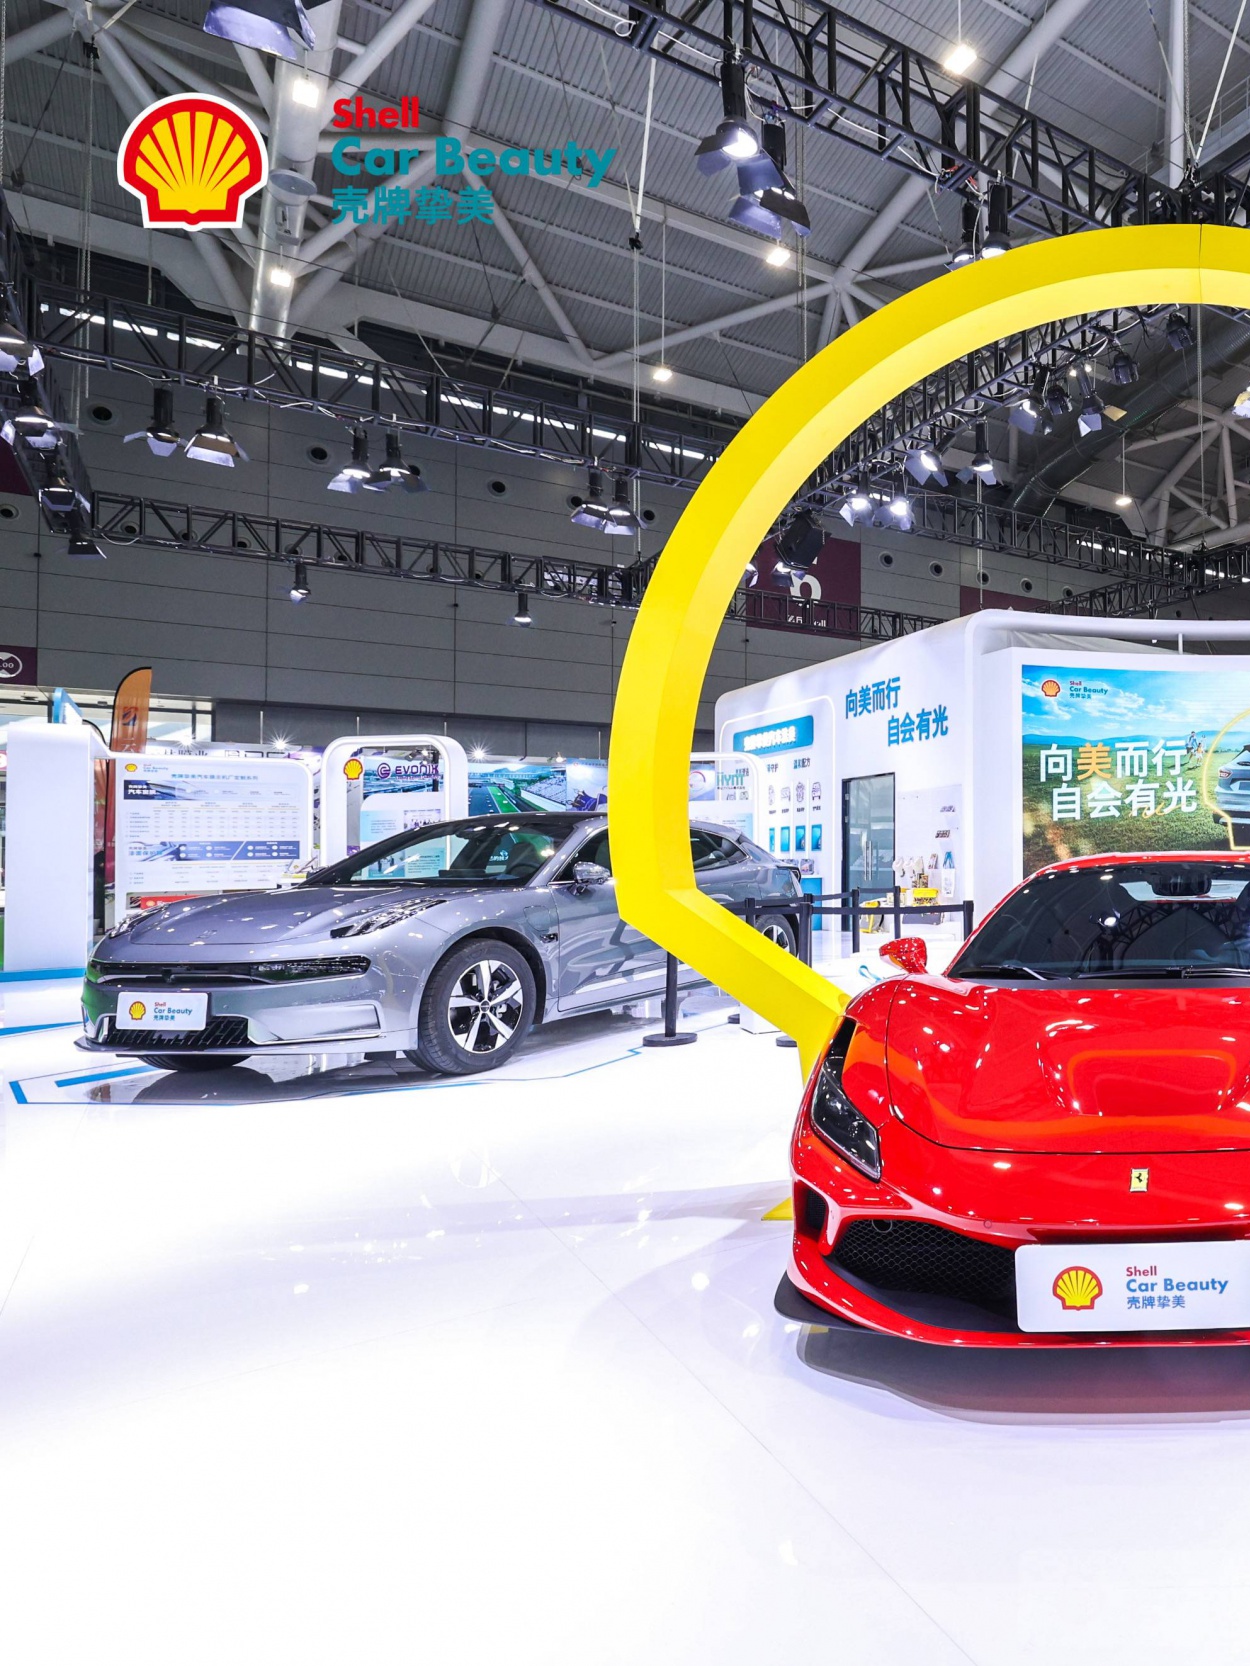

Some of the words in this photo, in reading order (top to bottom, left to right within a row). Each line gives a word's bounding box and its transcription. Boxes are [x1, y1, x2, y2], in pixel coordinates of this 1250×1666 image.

[845, 676, 901, 720] 向美而行
[1083, 686, 1108, 695] Beauty
[887, 704, 949, 747] 自会有光
[1039, 739, 1187, 783] 向美而行
[1052, 777, 1197, 821] 自会有光
[167, 1007, 193, 1016] Beauty
[1126, 1265, 1158, 1277] Shell
[1126, 1279, 1158, 1293] Car
[1164, 1278, 1229, 1295] Beauty
[1126, 1295, 1186, 1310] 壳牌挚美
